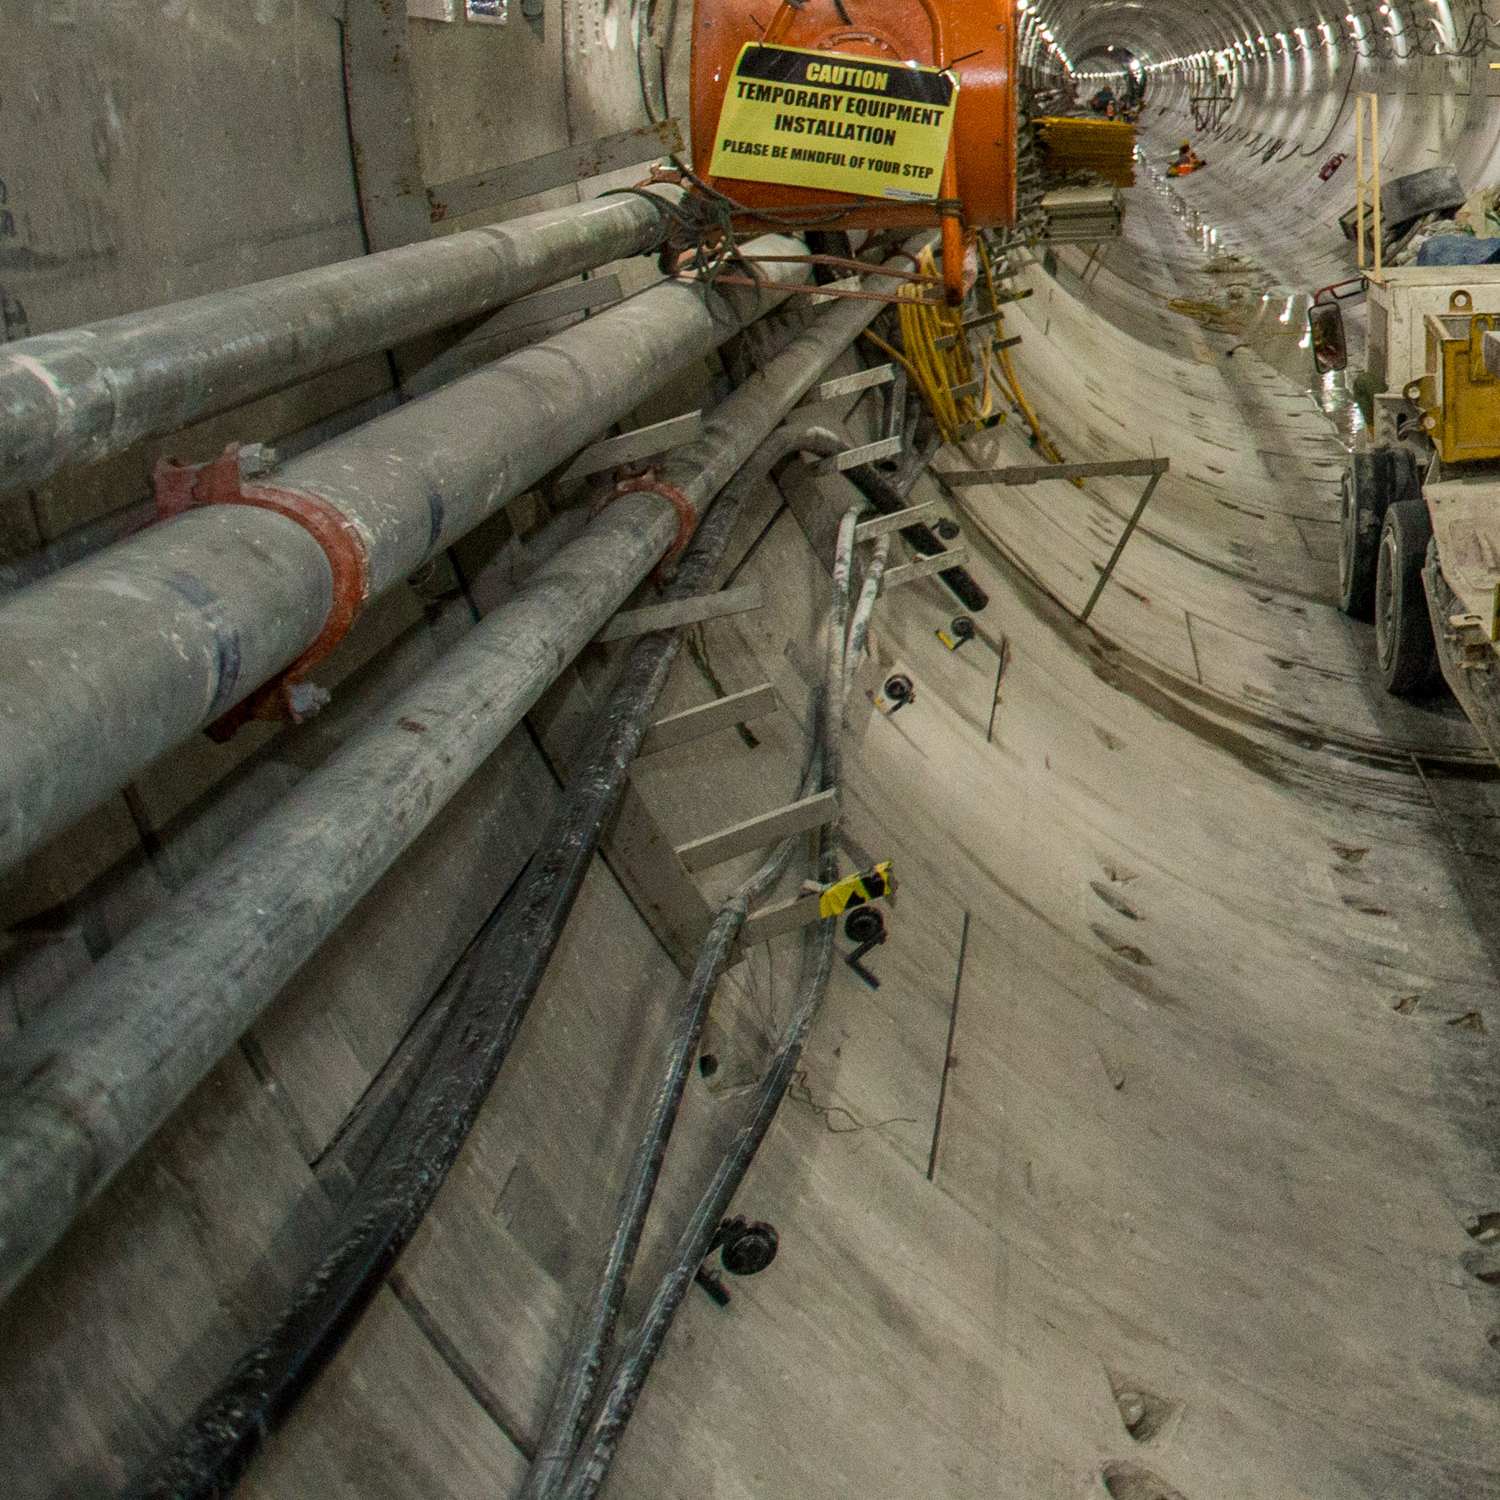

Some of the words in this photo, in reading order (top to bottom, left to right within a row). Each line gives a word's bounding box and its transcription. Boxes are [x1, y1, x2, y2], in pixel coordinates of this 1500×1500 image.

[805, 61, 889, 91] CAUTION
[737, 80, 844, 112] TEMPORARY
[845, 96, 944, 127] EQUIPMENT
[774, 113, 897, 146] INSTALLATION
[722, 139, 770, 157] PLEASE
[771, 145, 788, 159] BE
[790, 147, 847, 167] MINDFUL
[849, 155, 866, 170] OF
[867, 157, 901, 175] YOUR
[902, 163, 935, 180] STEP
